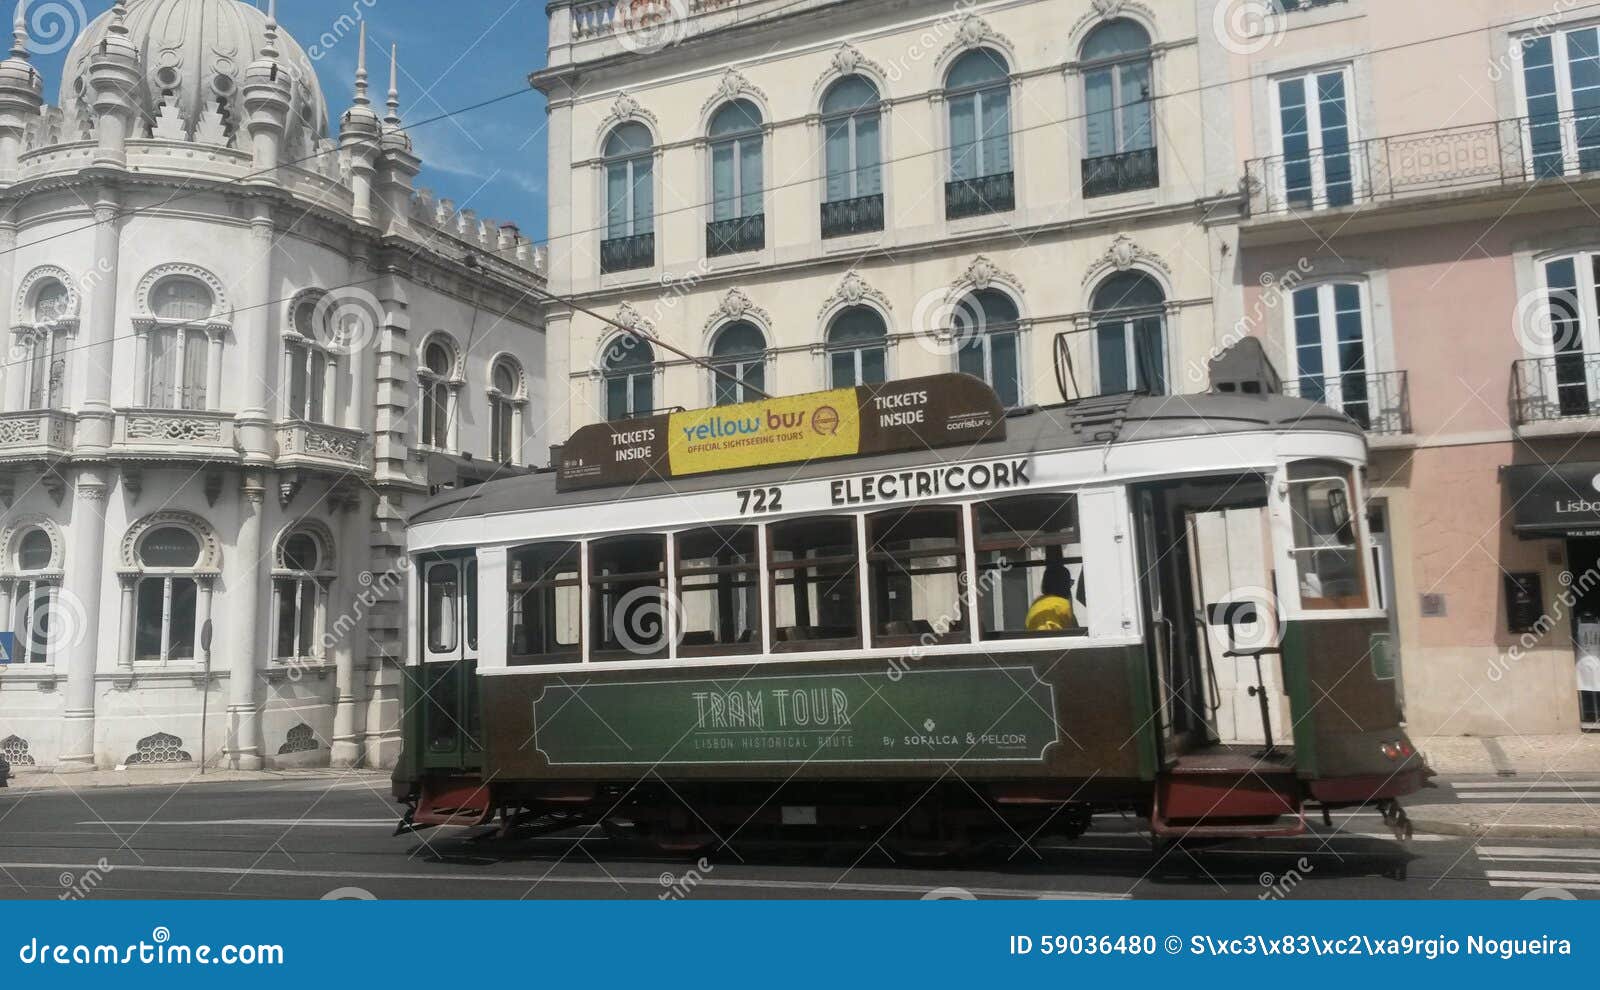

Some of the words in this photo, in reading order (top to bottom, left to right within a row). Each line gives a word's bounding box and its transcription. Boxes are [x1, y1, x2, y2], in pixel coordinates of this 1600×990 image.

[874, 391, 928, 410] TICKETS
[766, 408, 805, 431] bus
[880, 410, 924, 428] INSIDE
[610, 429, 656, 446] TICKETS
[687, 443, 721, 454] OFFICIAL
[723, 437, 774, 449] SIGHTSEEING
[777, 432, 804, 443] TOURS
[615, 446, 652, 462] INSIDE
[737, 488, 782, 514] 722
[692, 690, 765, 728] TRAM
[772, 688, 852, 727] TOUR
[695, 738, 733, 750] LISBON
[743, 736, 808, 749] HISTORICAL
[818, 736, 854, 747] ROUTE
[904, 736, 959, 745] SOFALCA
[965, 732, 976, 745] &
[981, 734, 1027, 745] PELCOR
